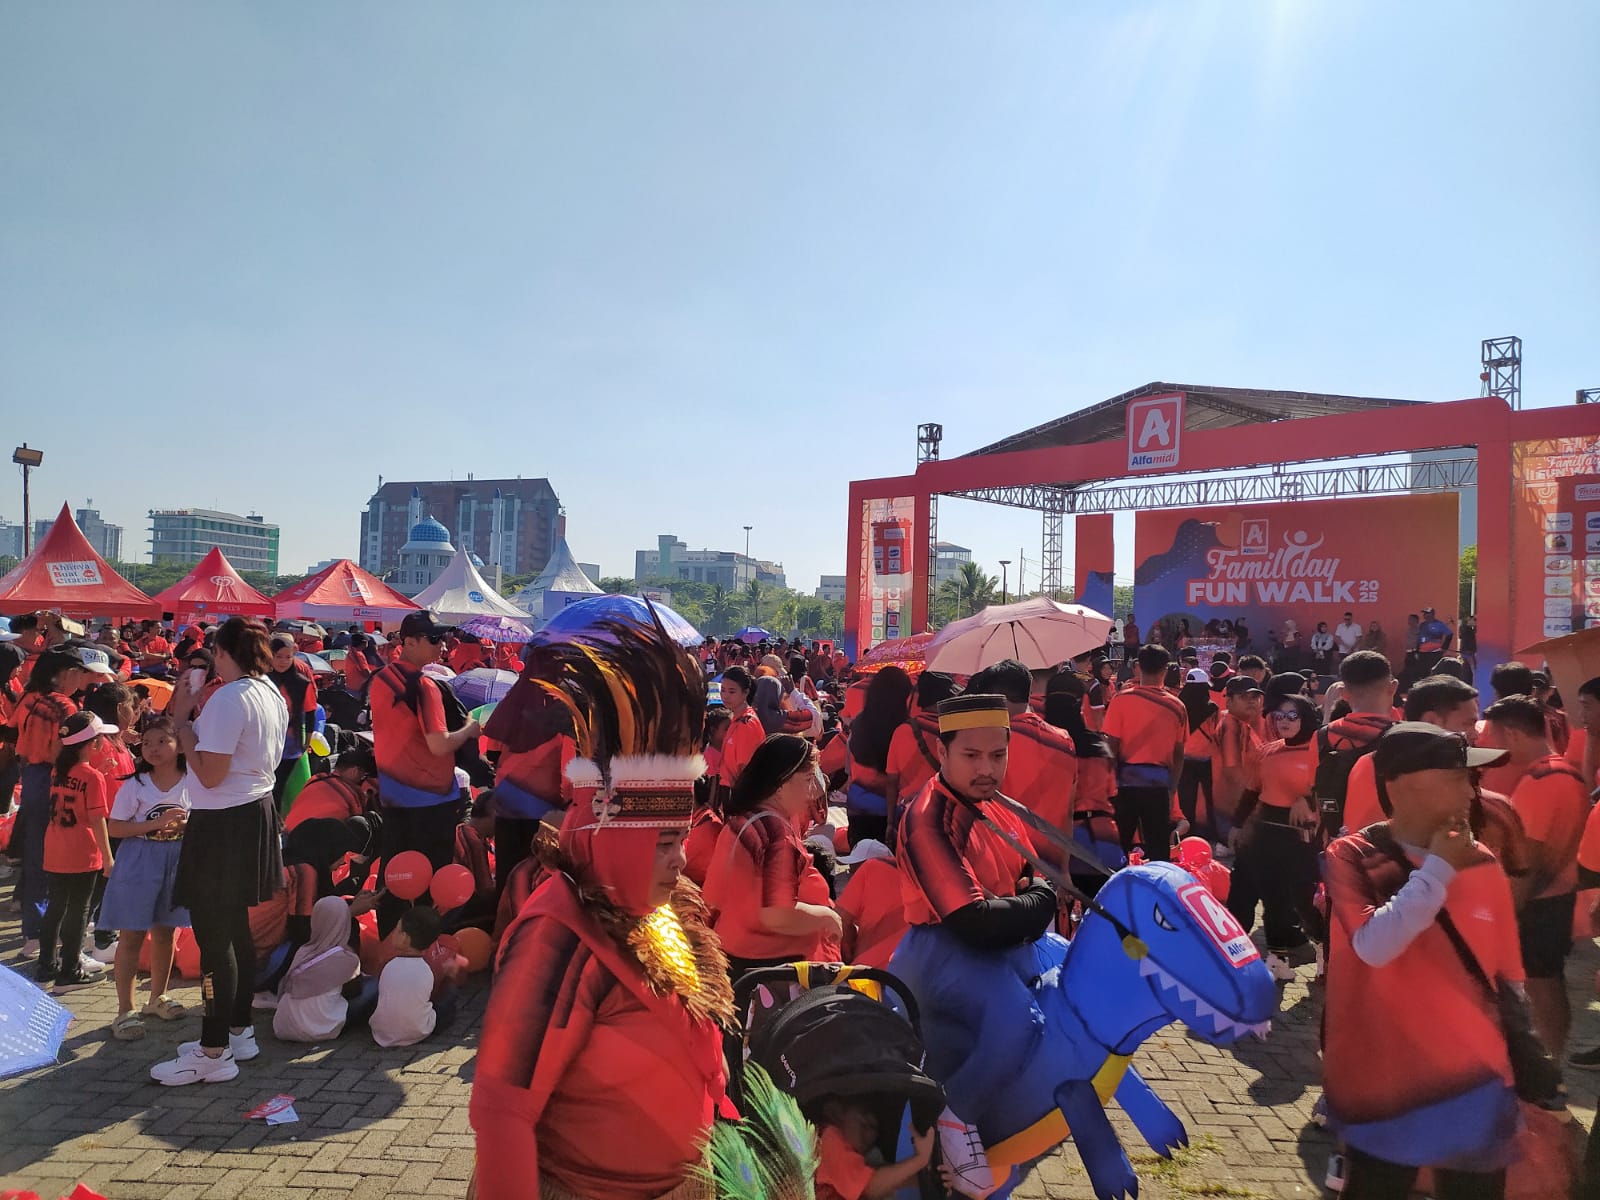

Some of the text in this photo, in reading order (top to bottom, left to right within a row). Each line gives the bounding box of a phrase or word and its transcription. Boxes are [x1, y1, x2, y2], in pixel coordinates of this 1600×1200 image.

[1138, 408, 1171, 448] A
[1131, 453, 1176, 466] Alfamidi
[1246, 524, 1263, 545] A
[1189, 580, 1355, 604] FUN WALK
[1200, 894, 1240, 936] A
